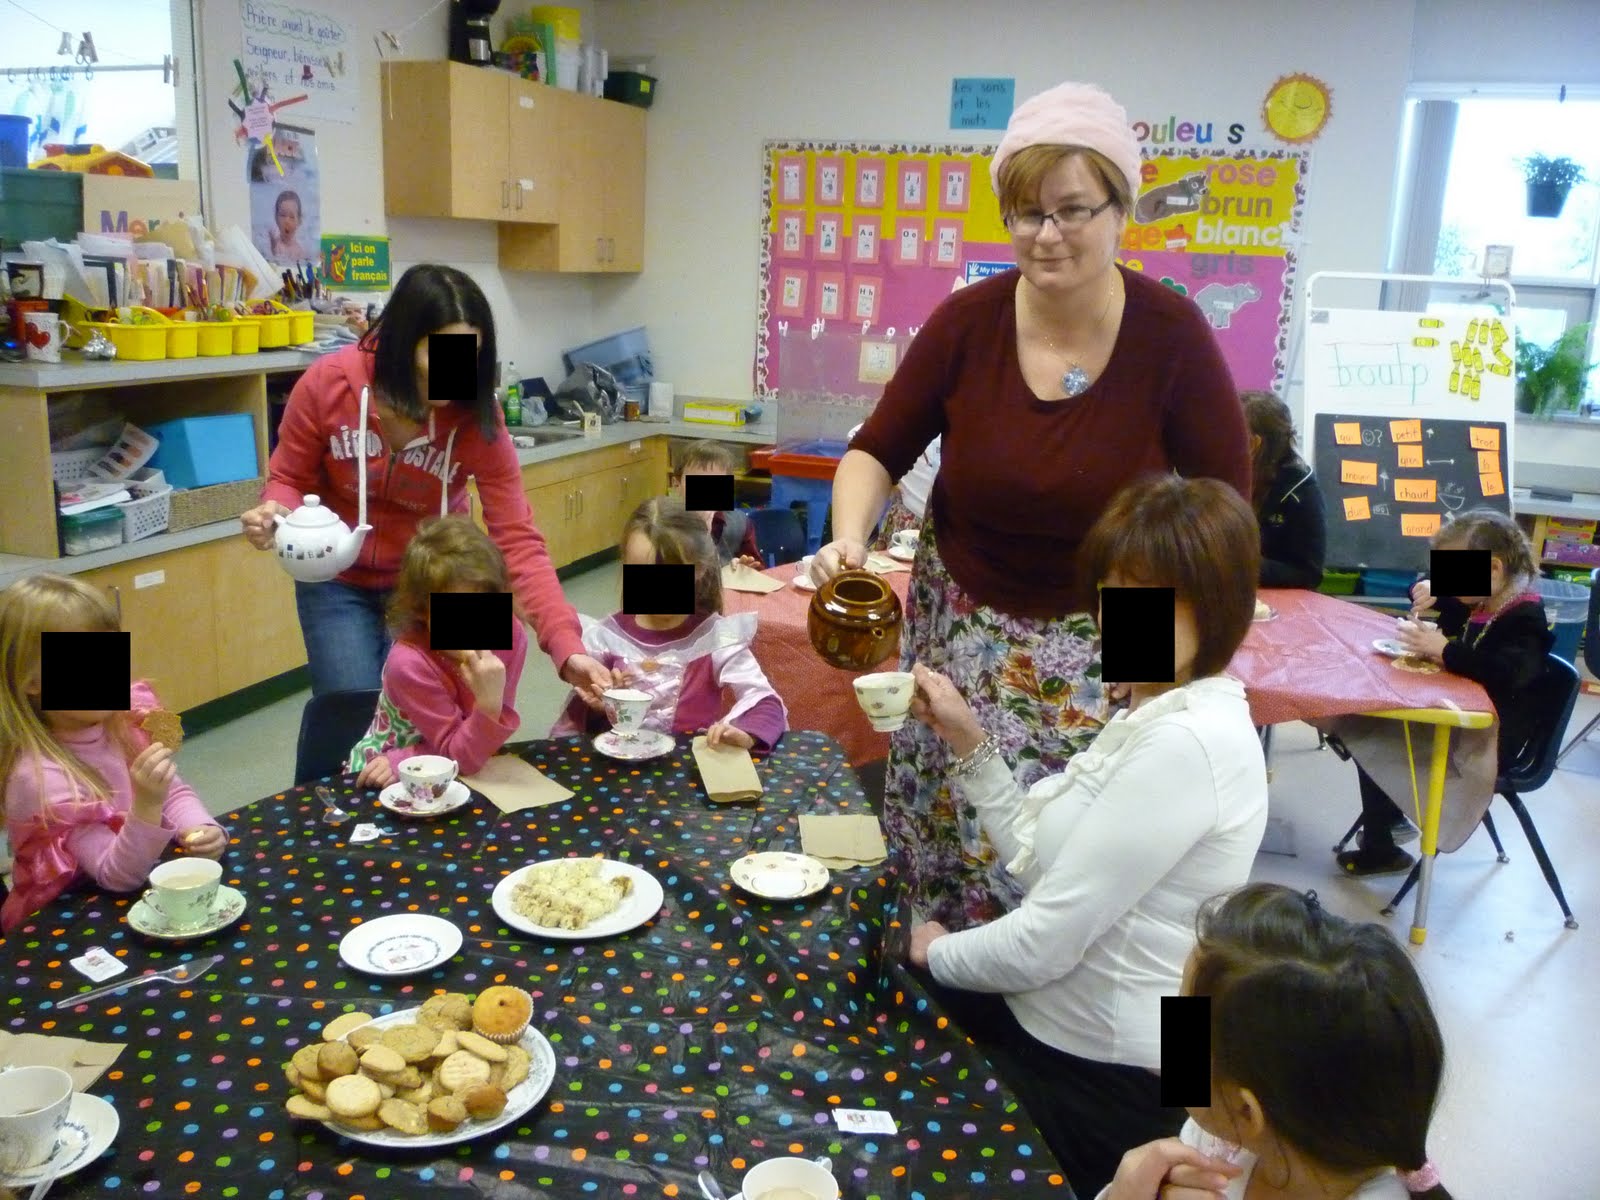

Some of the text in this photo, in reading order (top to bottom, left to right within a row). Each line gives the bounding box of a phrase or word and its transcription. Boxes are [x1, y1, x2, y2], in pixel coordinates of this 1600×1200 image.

[1132, 116, 1213, 144] ouleu
[1204, 163, 1277, 187] rose
[1201, 191, 1273, 218] brun
[350, 242, 376, 254] Ici on
[351, 256, 375, 268] parle
[1191, 250, 1255, 279] gris
[352, 270, 387, 282] français
[980, 266, 990, 275] My
[1400, 487, 1429, 499] chaud
